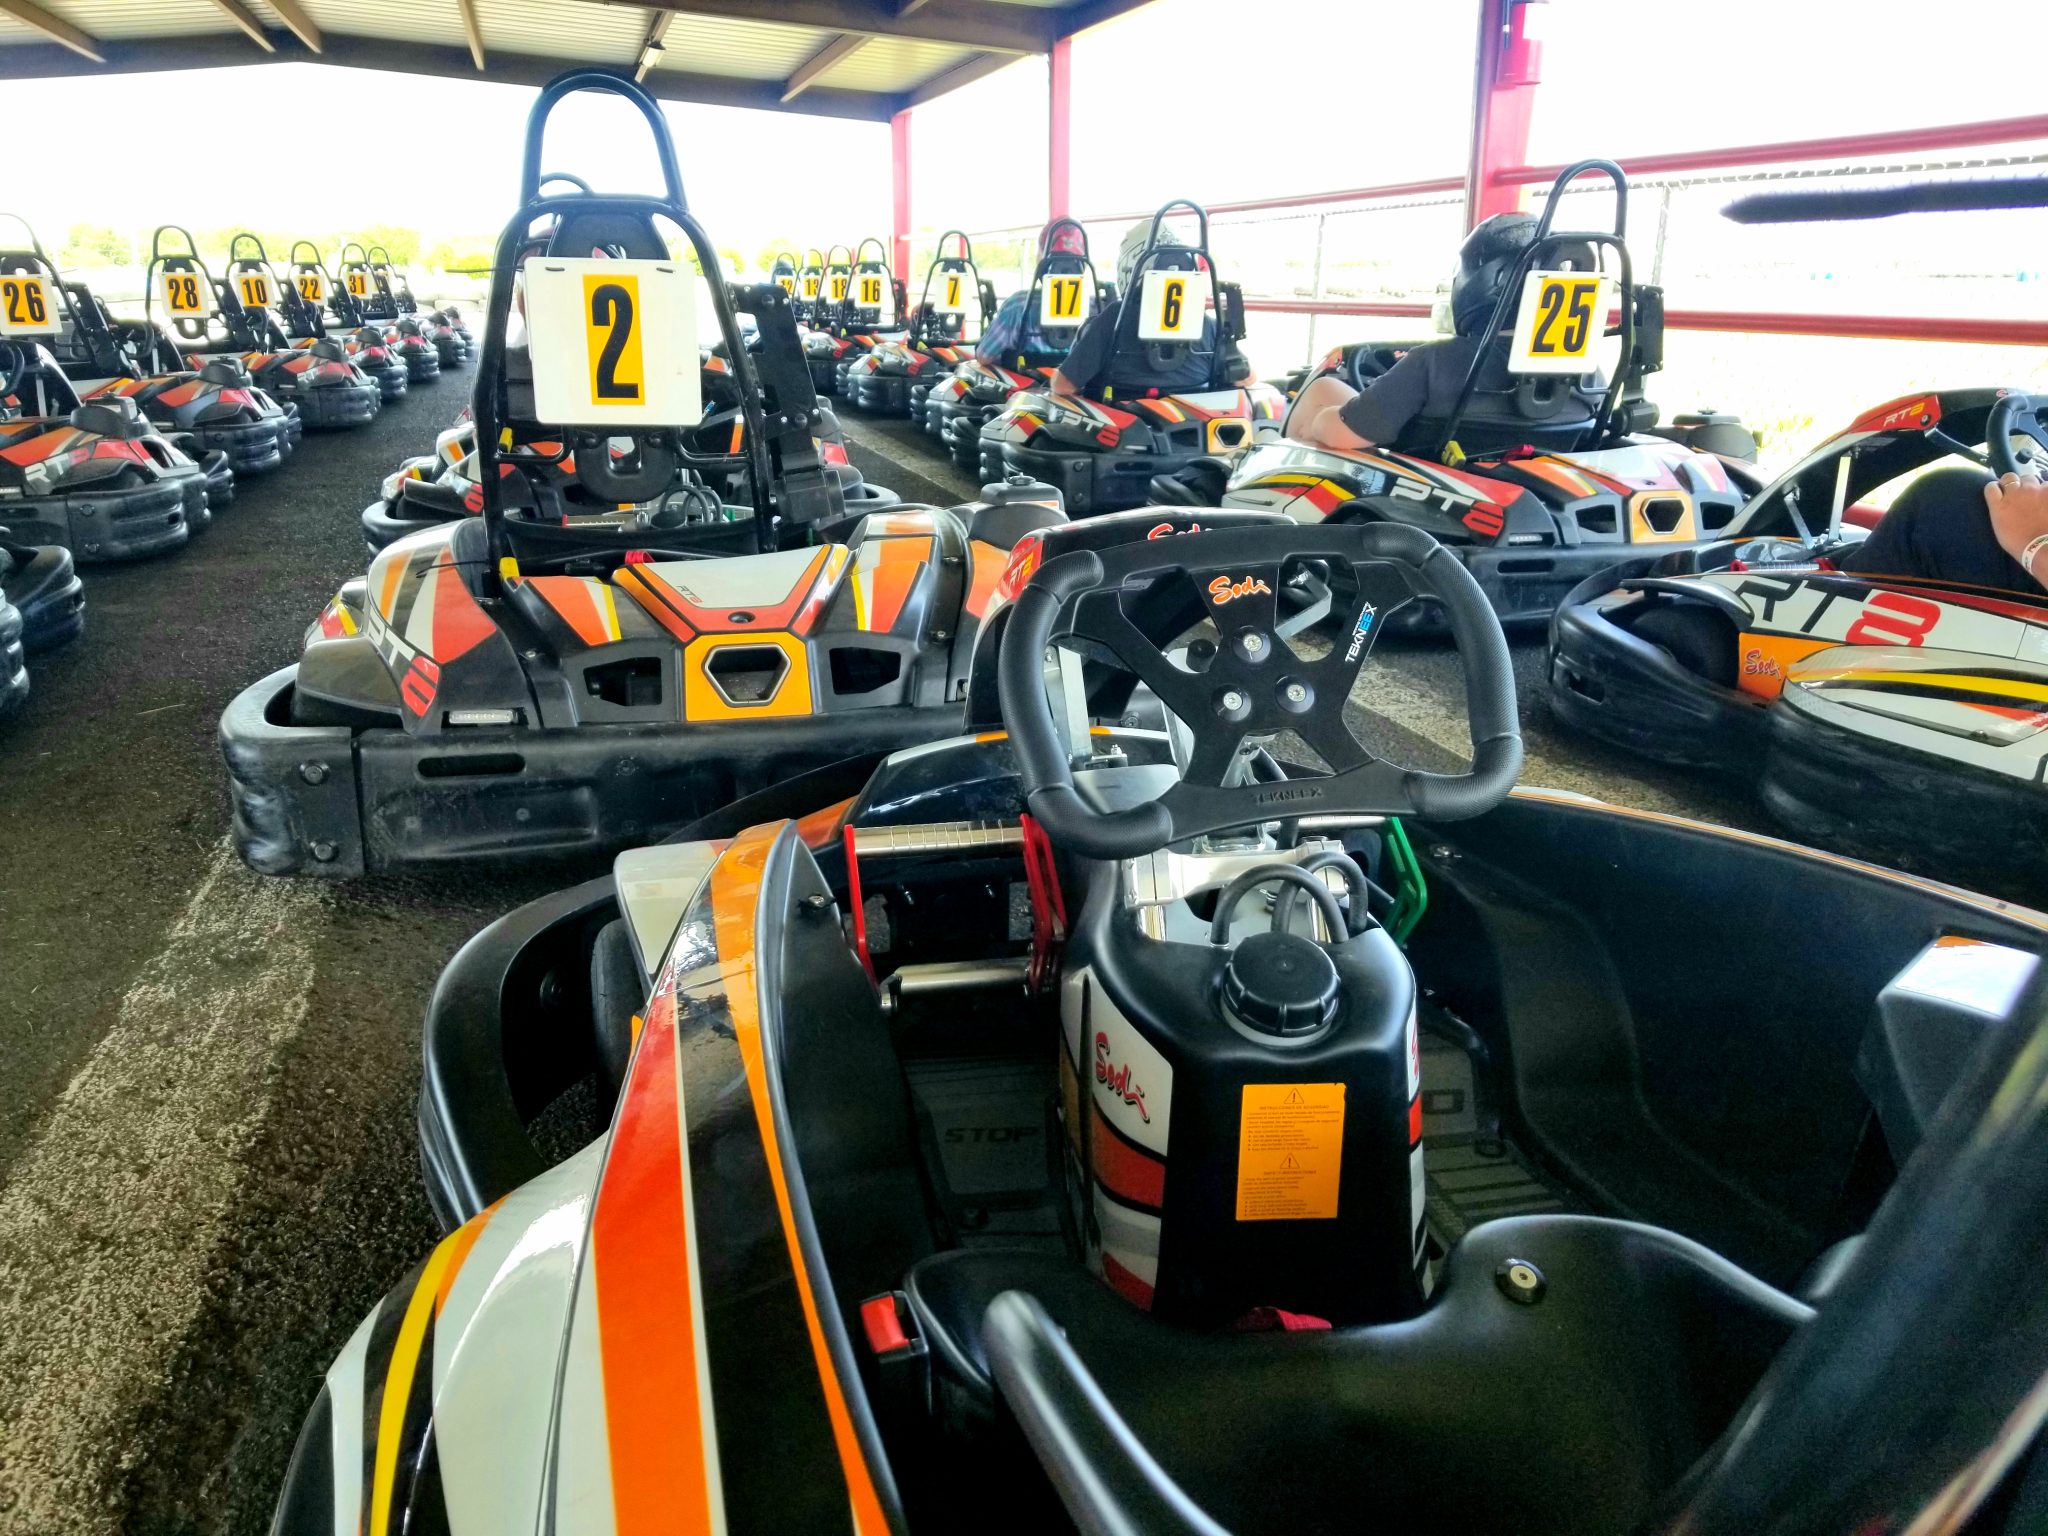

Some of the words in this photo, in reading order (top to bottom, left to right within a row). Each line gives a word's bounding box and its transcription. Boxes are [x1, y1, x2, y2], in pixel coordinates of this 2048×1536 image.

[168, 277, 199, 310] 28
[243, 278, 268, 304] 10
[300, 278, 321, 301] 22
[349, 275, 365, 294] 31
[863, 279, 880, 303] 16
[948, 278, 959, 306] 7
[1053, 280, 1080, 315] 17
[3, 282, 46, 323] 26
[1163, 282, 1182, 328] 6
[1532, 283, 1597, 353] 25
[592, 284, 639, 398] 2
[1884, 402, 1925, 428] RT8
[1208, 575, 1272, 605] Sodi
[1733, 576, 1942, 647] RT8
[1345, 602, 1377, 662] TEKNEEX
[944, 1126, 1040, 1143] STOP
